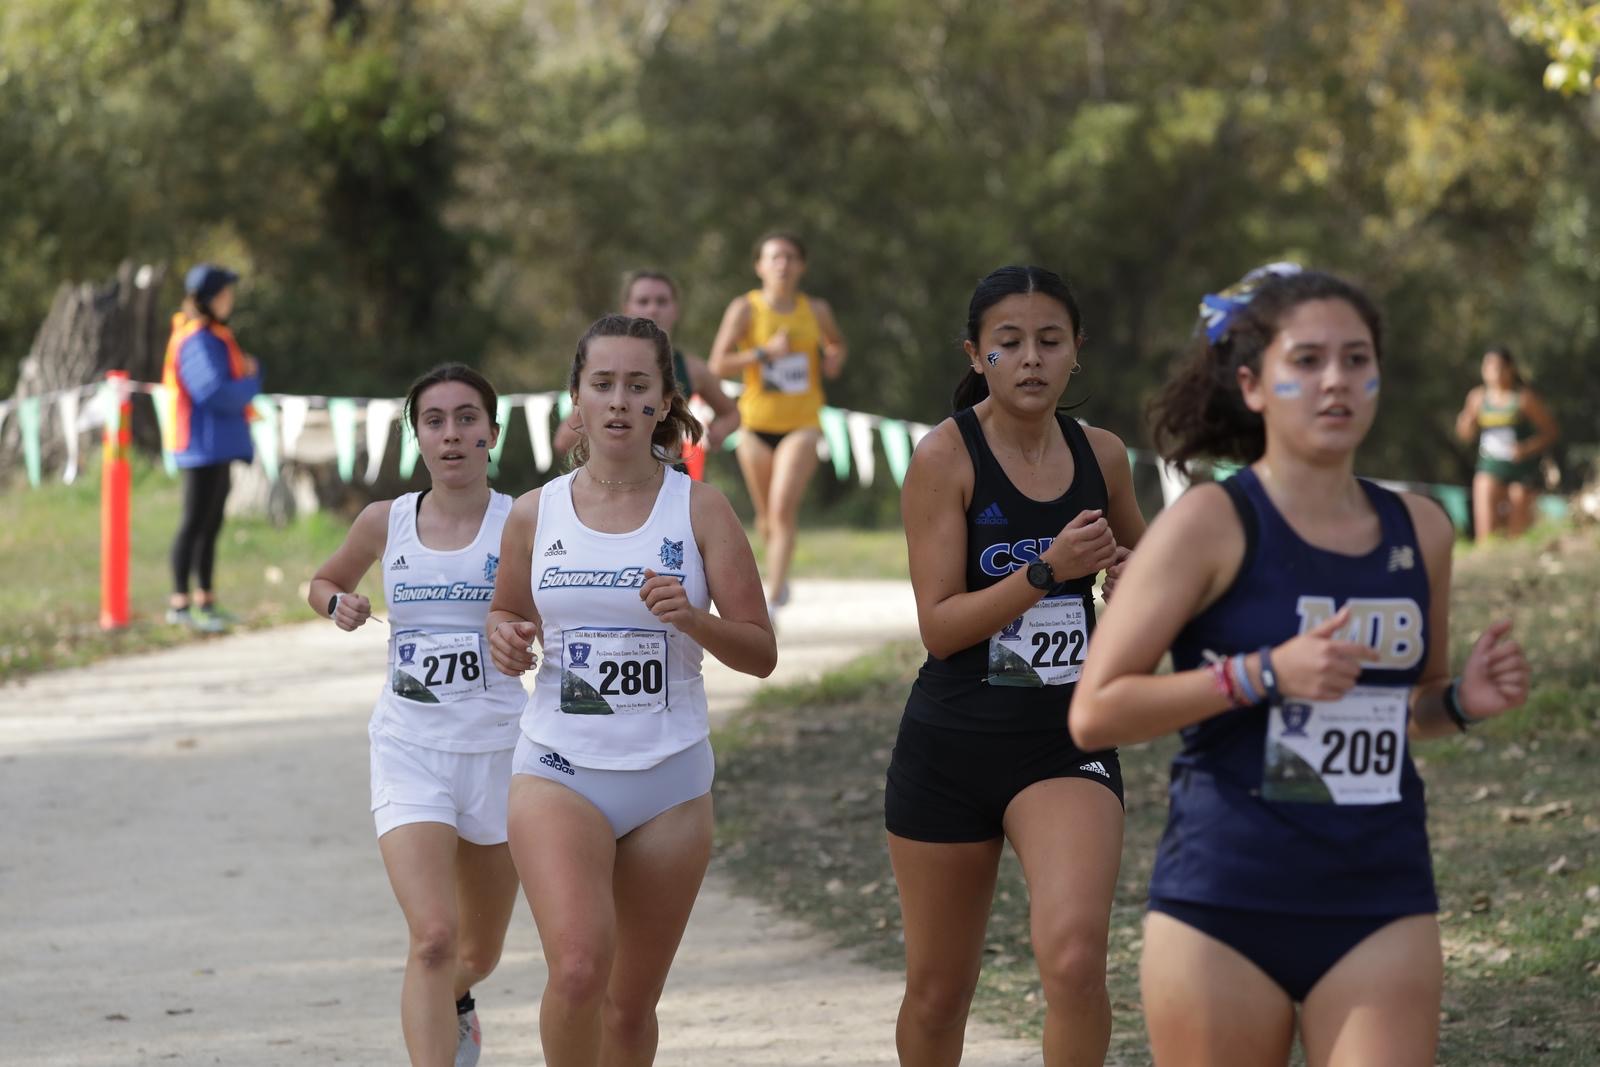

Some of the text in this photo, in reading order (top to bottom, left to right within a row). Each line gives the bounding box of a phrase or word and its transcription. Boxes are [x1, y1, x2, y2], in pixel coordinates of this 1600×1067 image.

[1031, 630, 1085, 667] 222
[423, 651, 480, 687] 278
[599, 660, 662, 695] 280
[540, 756, 575, 775] adidas
[1321, 729, 1397, 775] 209
[1080, 765, 1110, 778] adidas
